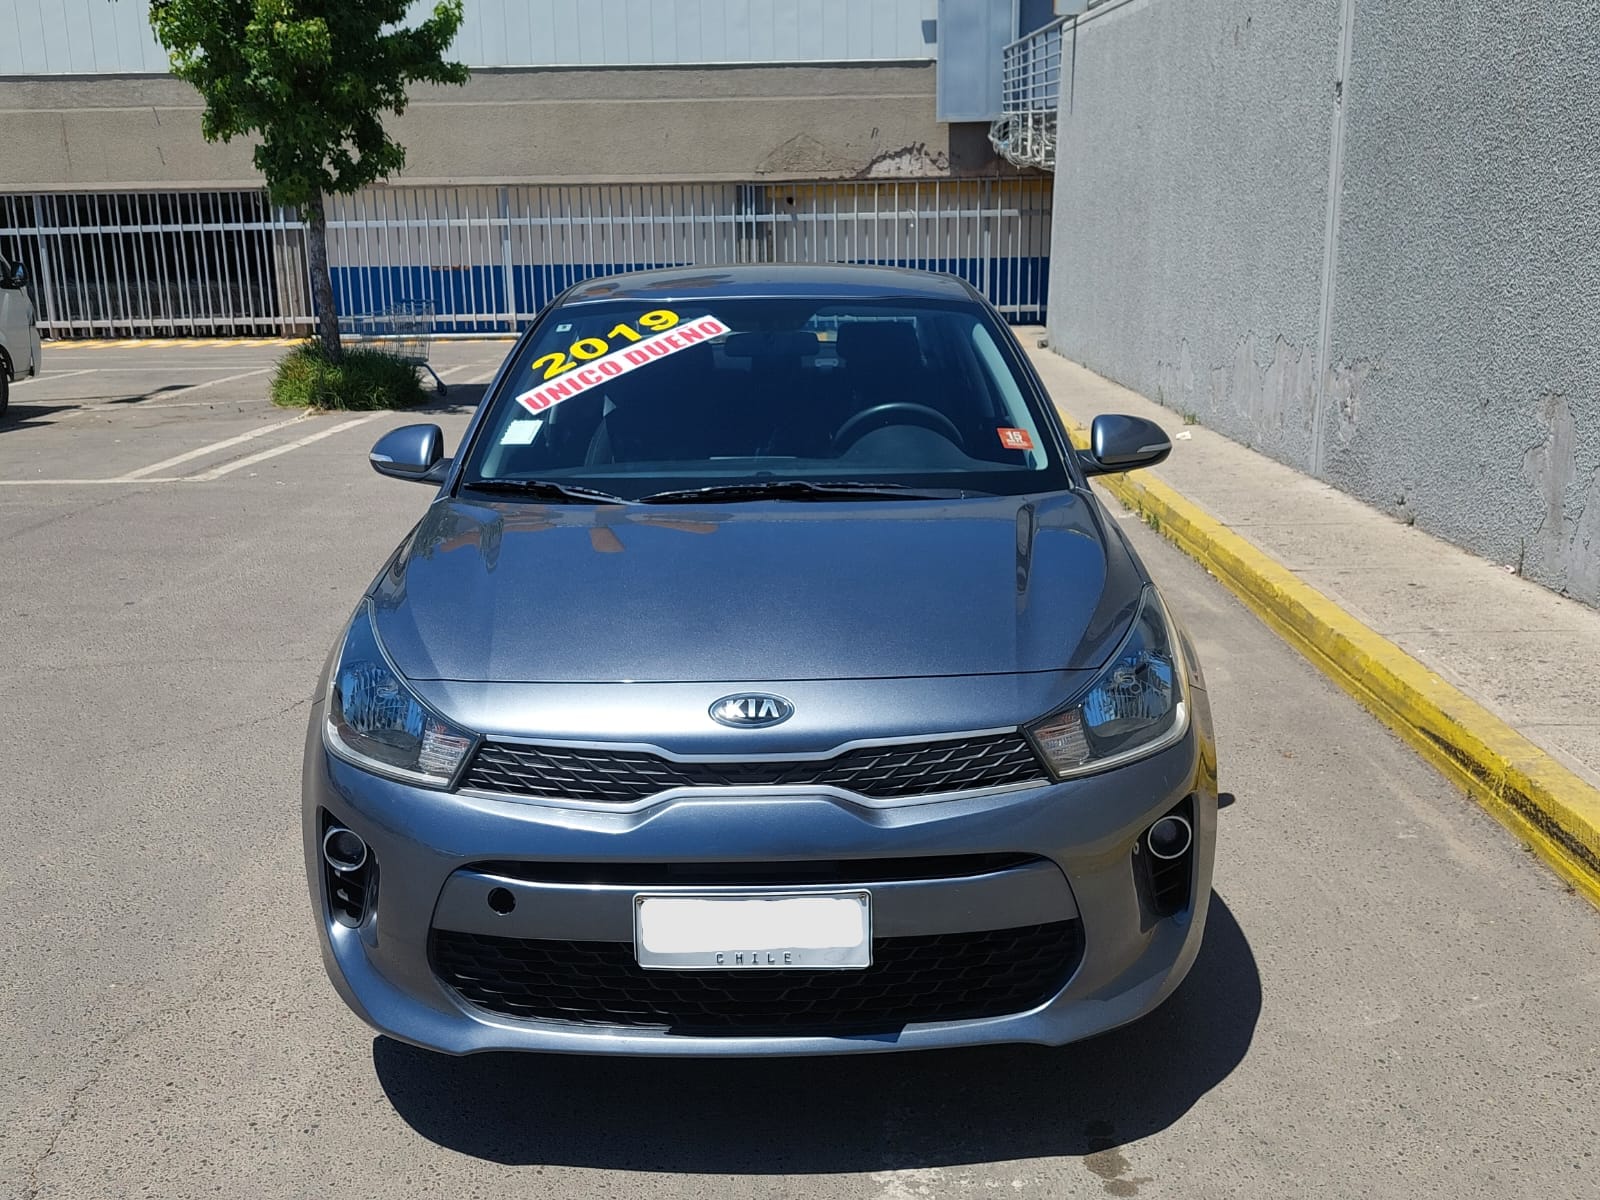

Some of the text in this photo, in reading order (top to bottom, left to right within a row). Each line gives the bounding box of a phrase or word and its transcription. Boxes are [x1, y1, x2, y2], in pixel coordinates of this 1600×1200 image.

[524, 321, 724, 410] UNICO DUEÑO
[532, 309, 680, 380] 2019
[725, 698, 780, 719] KIA
[716, 952, 793, 965] CHILE
